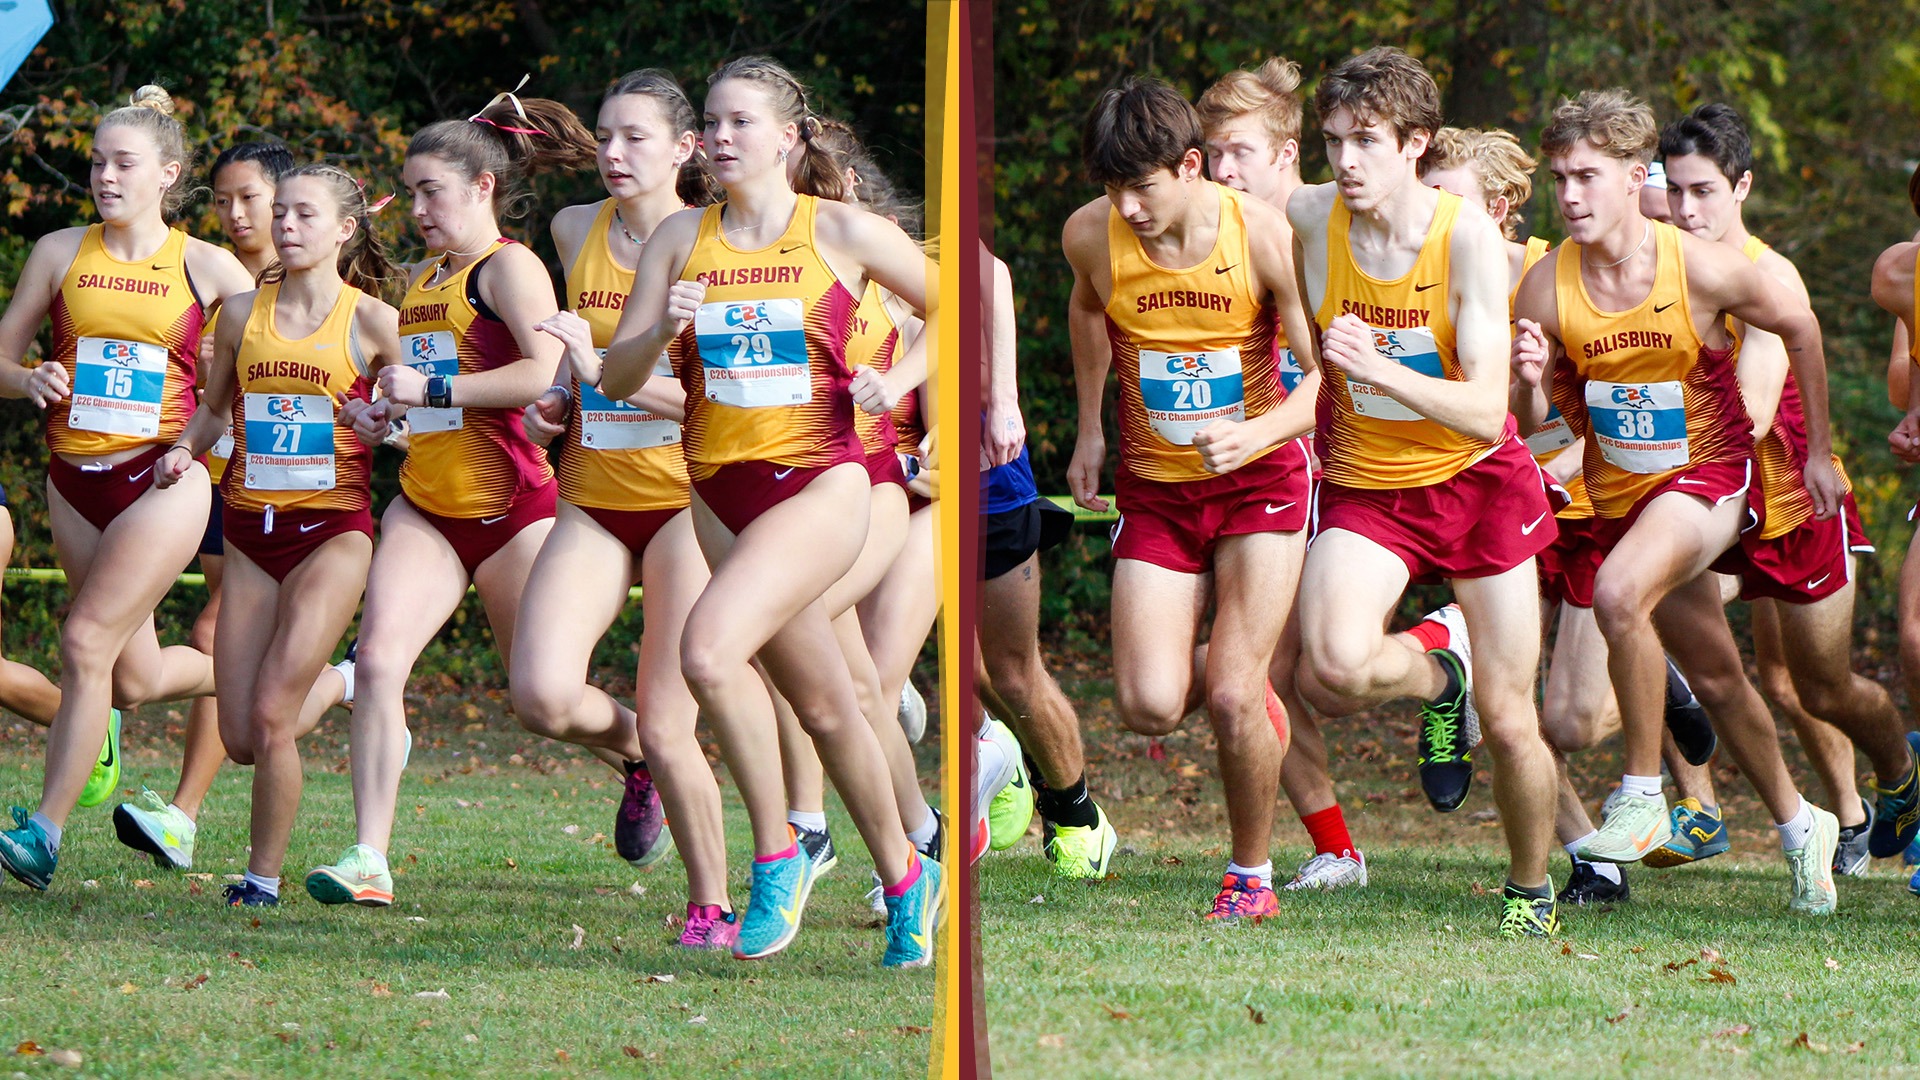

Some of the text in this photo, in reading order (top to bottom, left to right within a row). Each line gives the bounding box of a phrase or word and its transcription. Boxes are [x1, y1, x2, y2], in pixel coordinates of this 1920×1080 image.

[77, 274, 171, 297] SALISBURY
[577, 290, 630, 311] SALIS
[1137, 290, 1233, 314] SALISBURY
[399, 303, 450, 327] ALISBURY
[724, 305, 768, 327] C2C
[1342, 299, 1430, 328] SALISBURY
[731, 333, 773, 365] 29
[1373, 332, 1400, 347] 2C
[1583, 331, 1673, 360] SALISBURY
[102, 343, 138, 361] C2C
[247, 361, 331, 388] SALISBURY
[710, 366, 803, 380] C2C Championships
[1166, 354, 1209, 374] C2C
[104, 369, 133, 398] 15
[77, 395, 155, 415] C2C Championships
[1172, 381, 1211, 409] 20
[1611, 388, 1651, 404] C2C
[267, 398, 304, 416] C2C
[587, 412, 665, 423] C2C Champions
[1150, 405, 1239, 422] C2C Championships
[1617, 410, 1655, 439] 38
[272, 423, 302, 453] 27
[1614, 440, 1682, 452] Championships
[250, 454, 329, 467] C2C Championships
